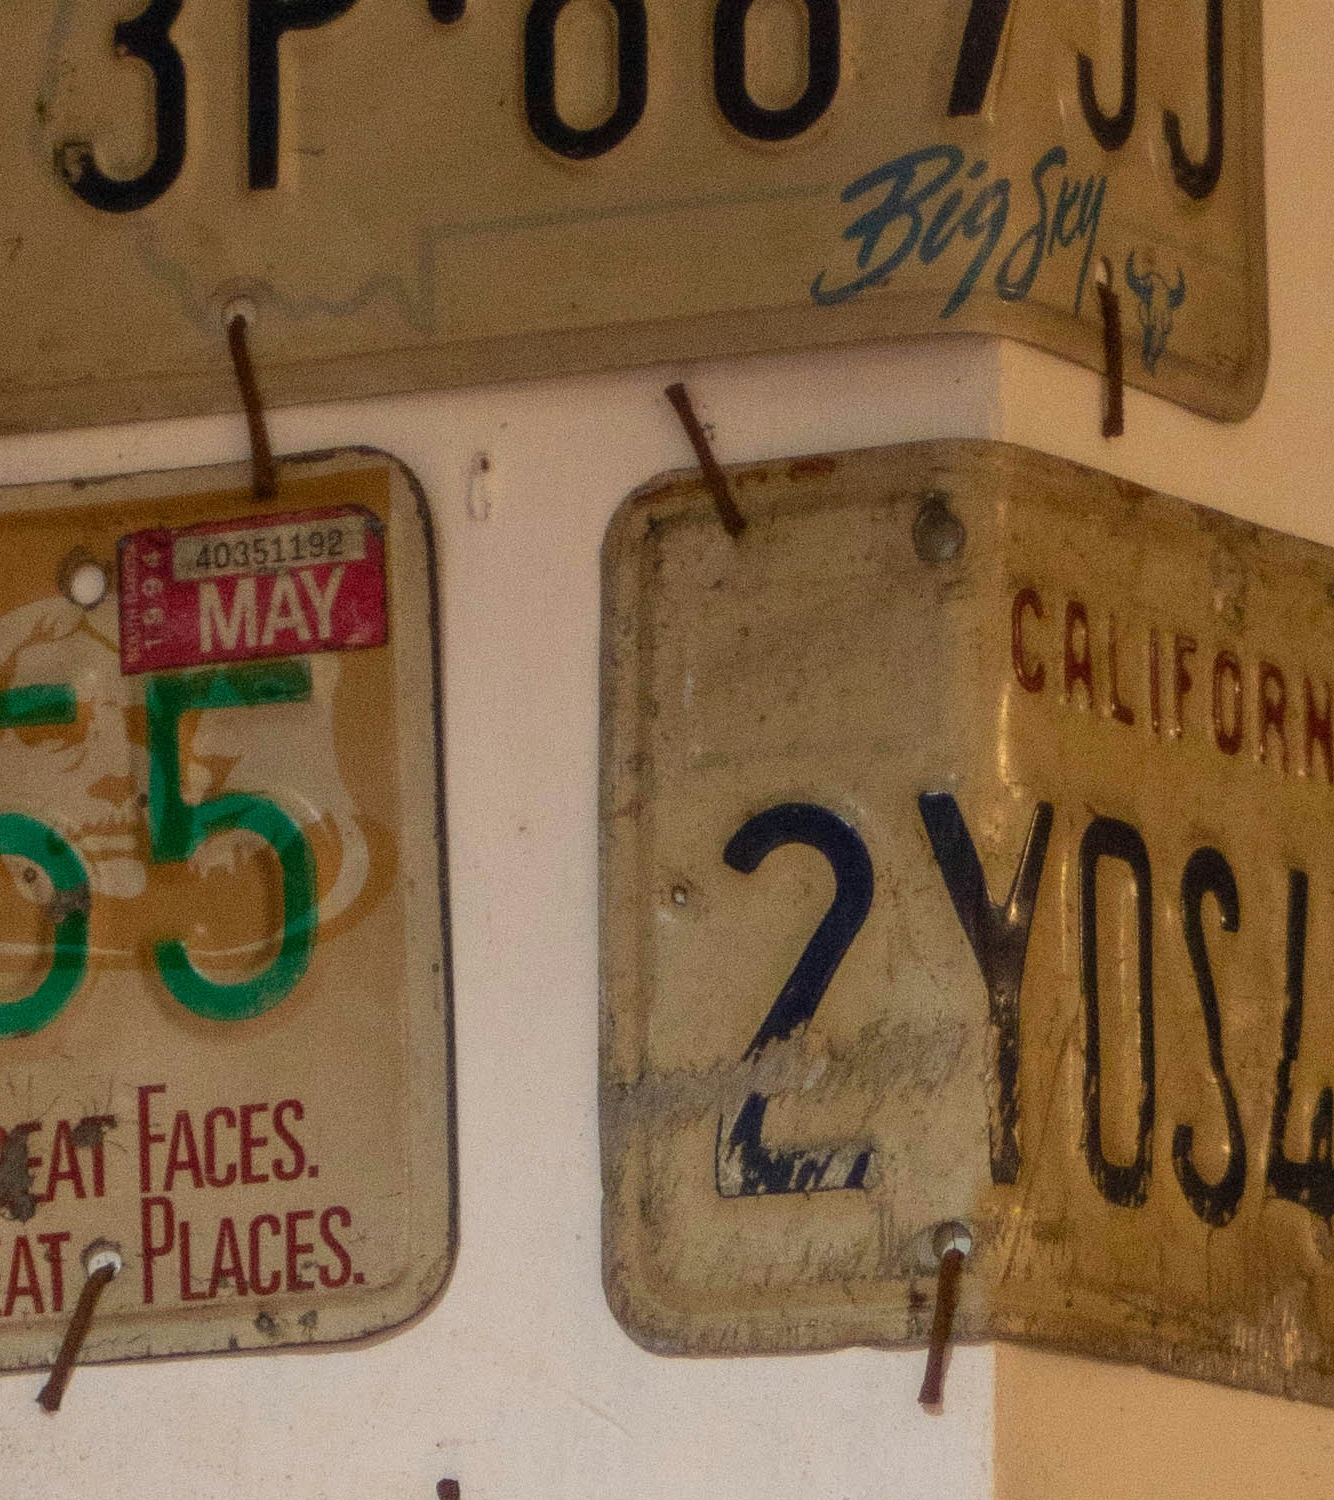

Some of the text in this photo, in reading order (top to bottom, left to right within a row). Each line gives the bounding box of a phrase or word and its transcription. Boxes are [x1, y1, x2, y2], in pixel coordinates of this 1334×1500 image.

[811, 145, 1011, 320] Big
[141, 550, 165, 647] 1994
[199, 566, 346, 653] MAY
